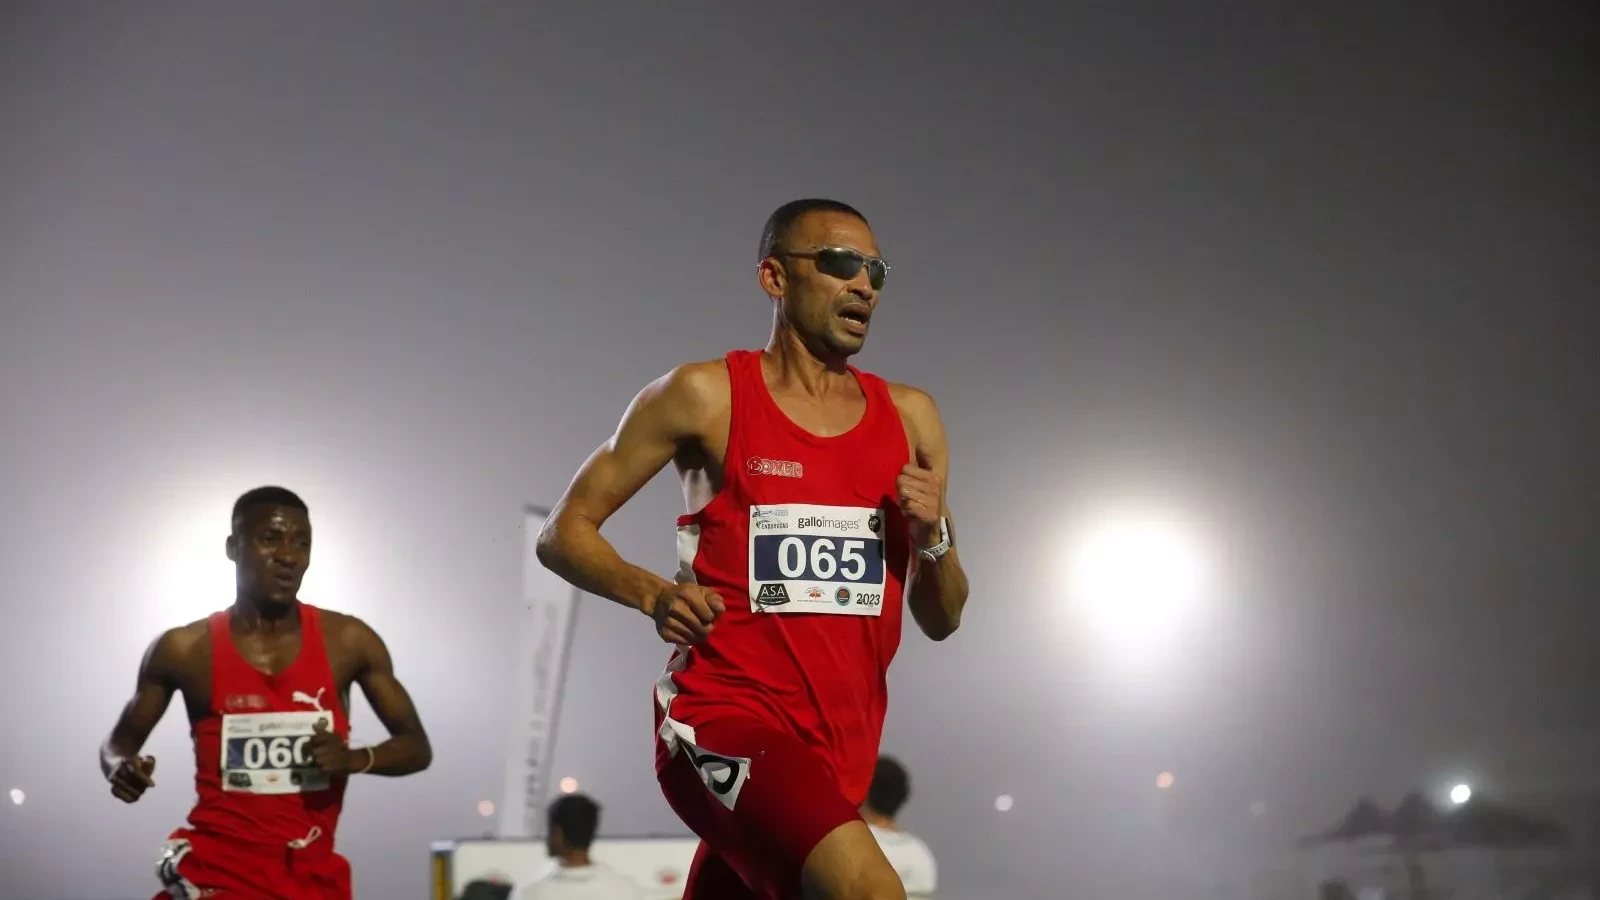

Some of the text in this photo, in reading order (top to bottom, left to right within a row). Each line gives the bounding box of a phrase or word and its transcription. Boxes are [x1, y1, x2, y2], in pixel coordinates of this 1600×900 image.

[798, 516, 861, 531] galloimages
[778, 536, 866, 580] 065
[761, 585, 785, 597] ASA
[856, 592, 881, 606] 2023
